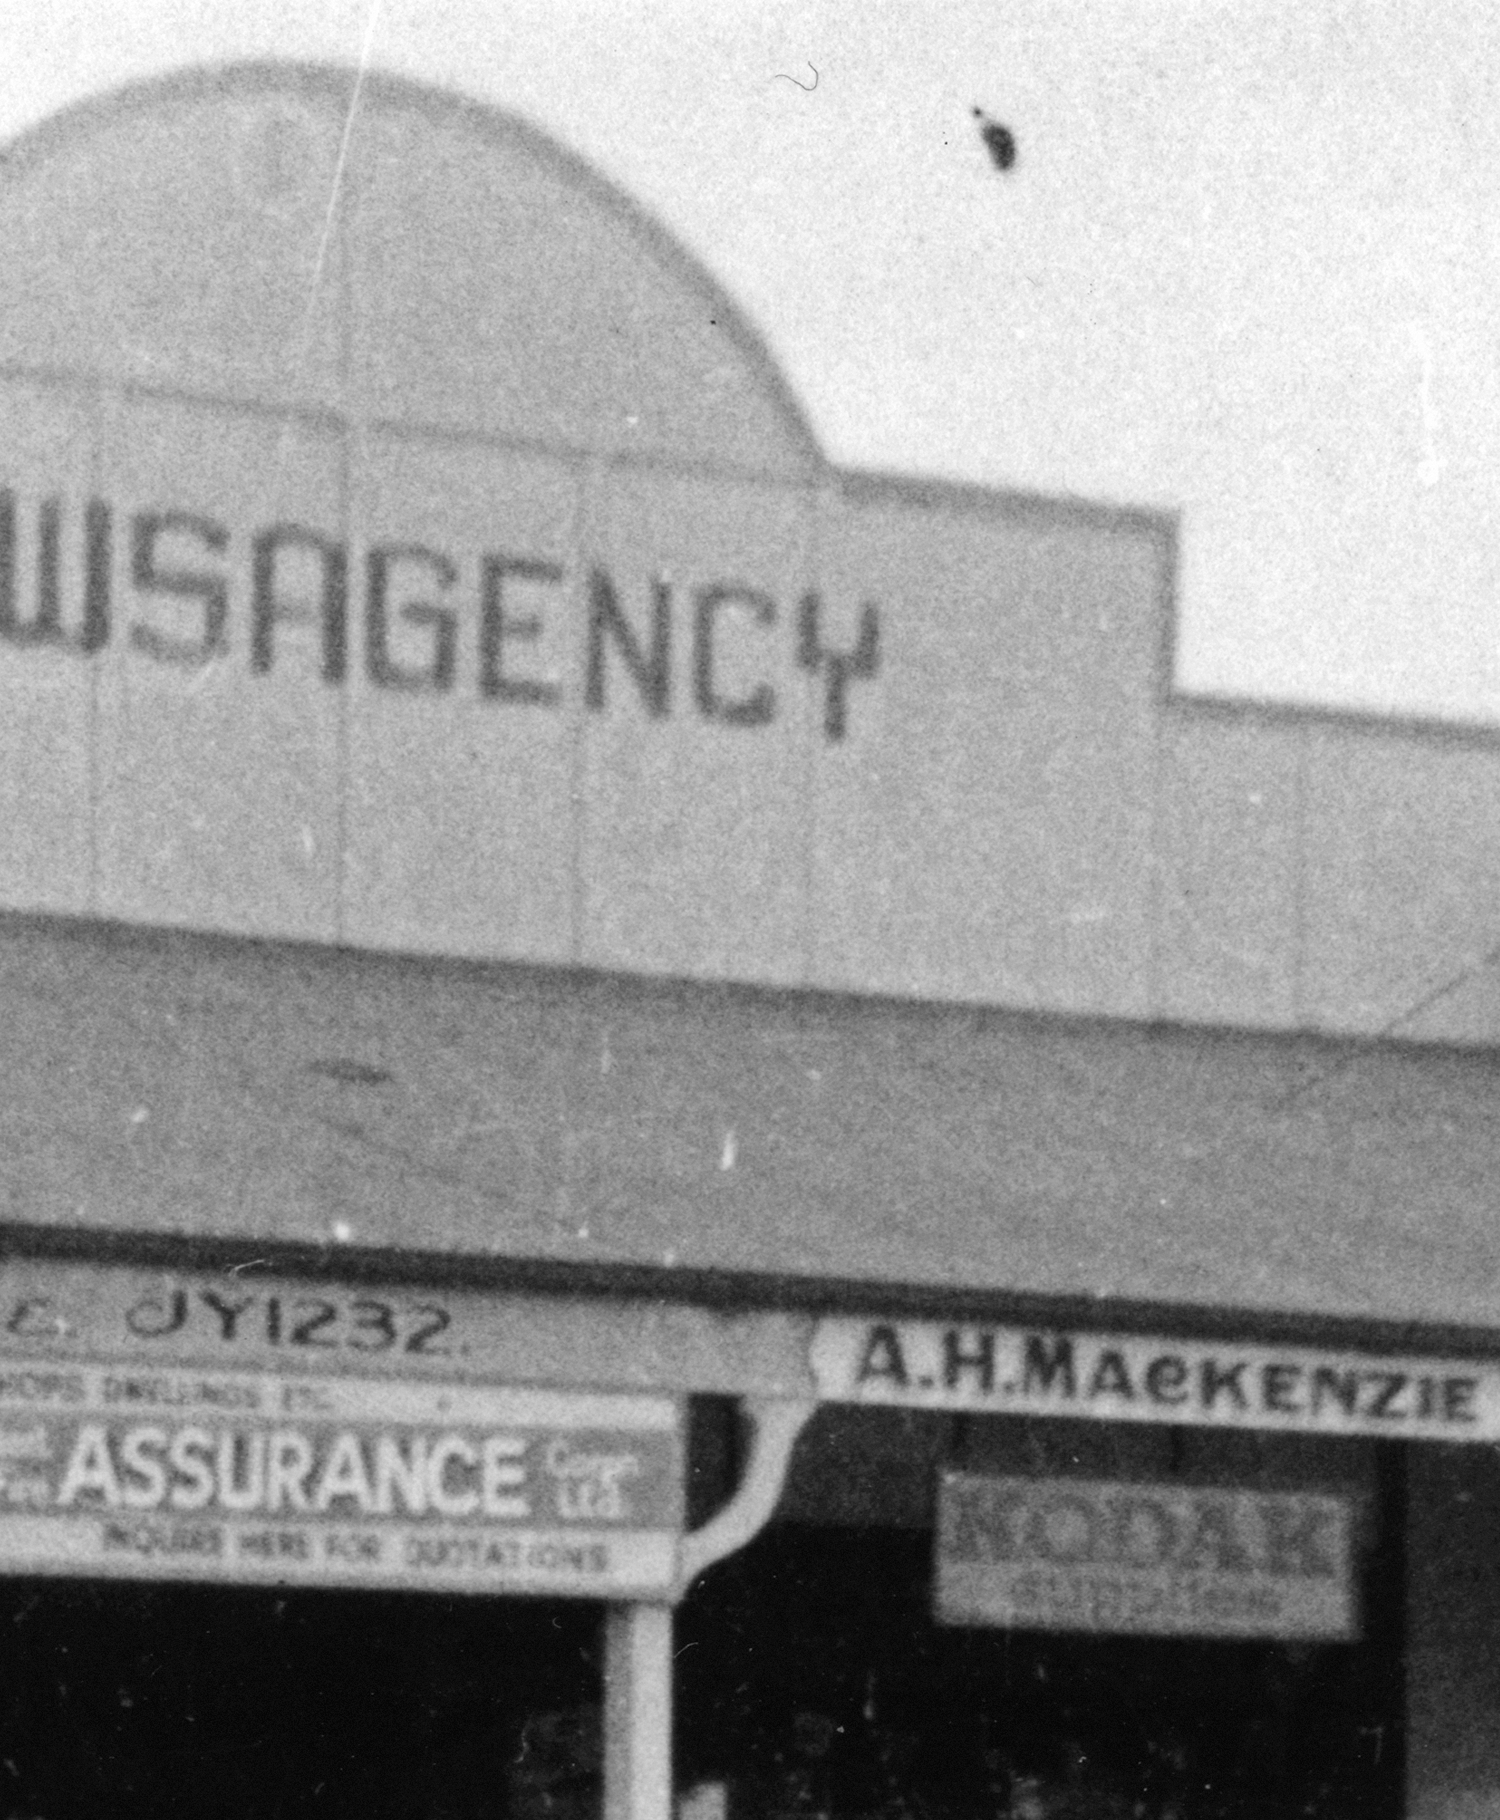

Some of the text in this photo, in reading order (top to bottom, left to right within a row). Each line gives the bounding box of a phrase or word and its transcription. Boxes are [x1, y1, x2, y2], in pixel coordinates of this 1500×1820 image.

[58, 1425, 530, 1517] ASSURANCE
[404, 1536, 609, 1573] QUOTATIONS
[945, 1491, 1338, 1578] KODAK
